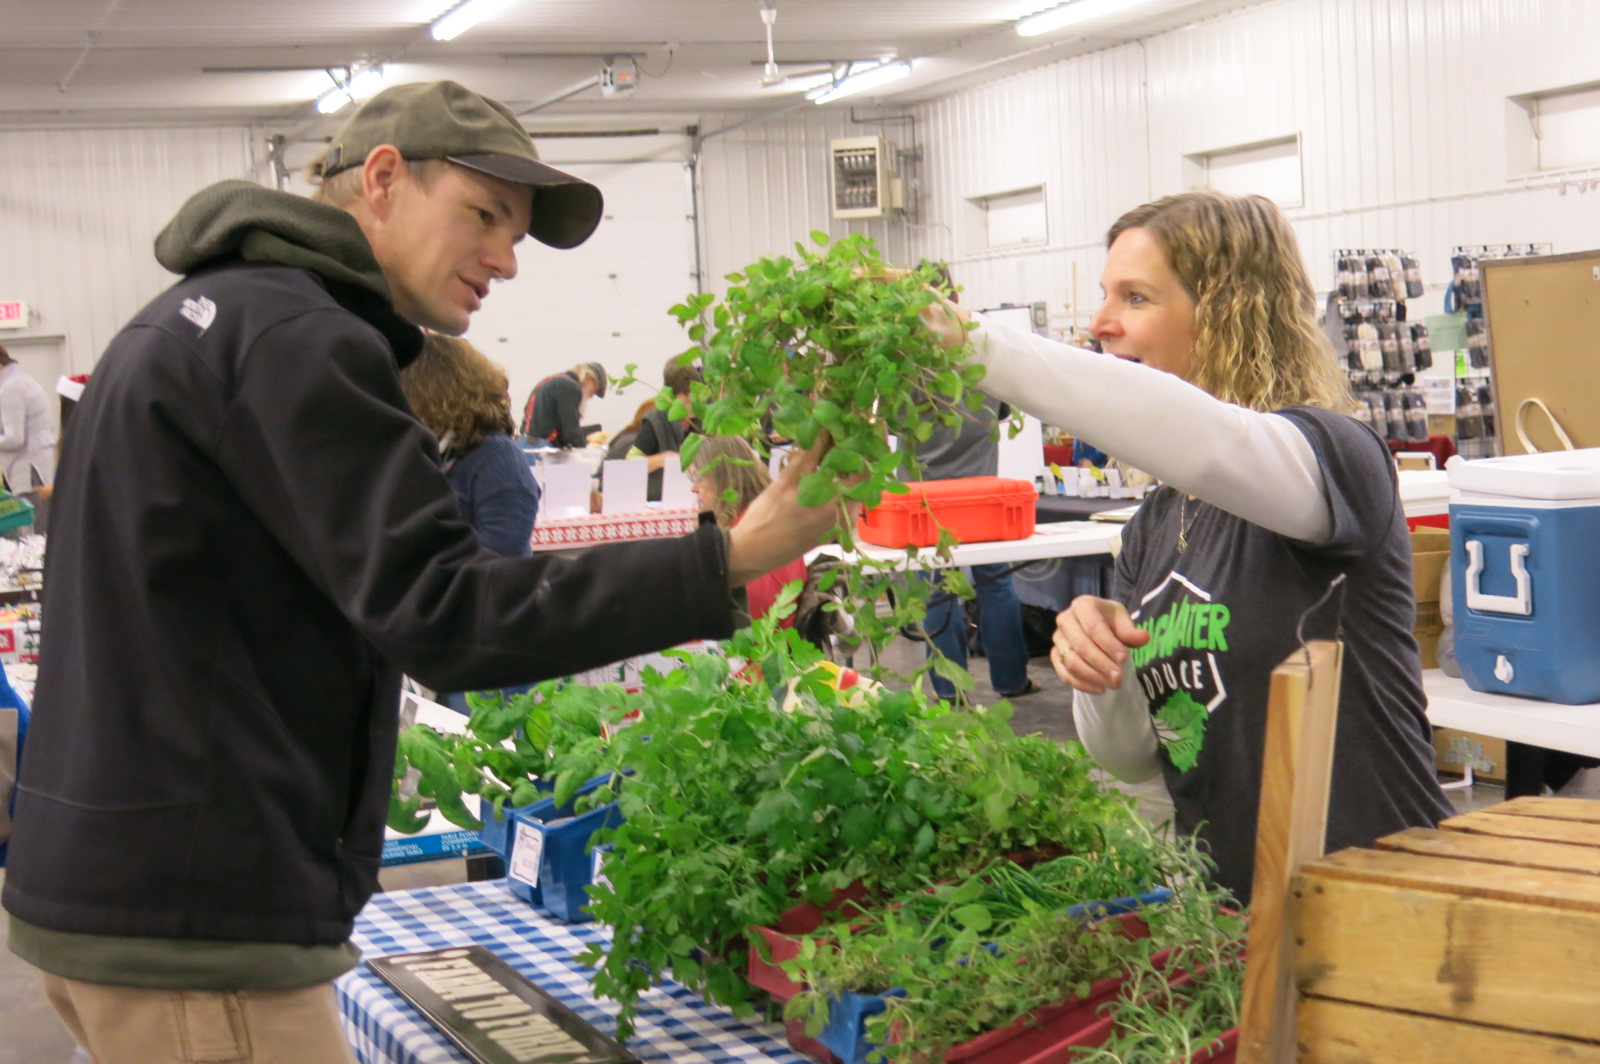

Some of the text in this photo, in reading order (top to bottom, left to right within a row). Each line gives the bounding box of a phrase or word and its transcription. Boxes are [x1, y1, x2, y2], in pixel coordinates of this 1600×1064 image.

[1142, 659, 1203, 700] ODUCE
[404, 957, 591, 1062] FARM TO FORK
